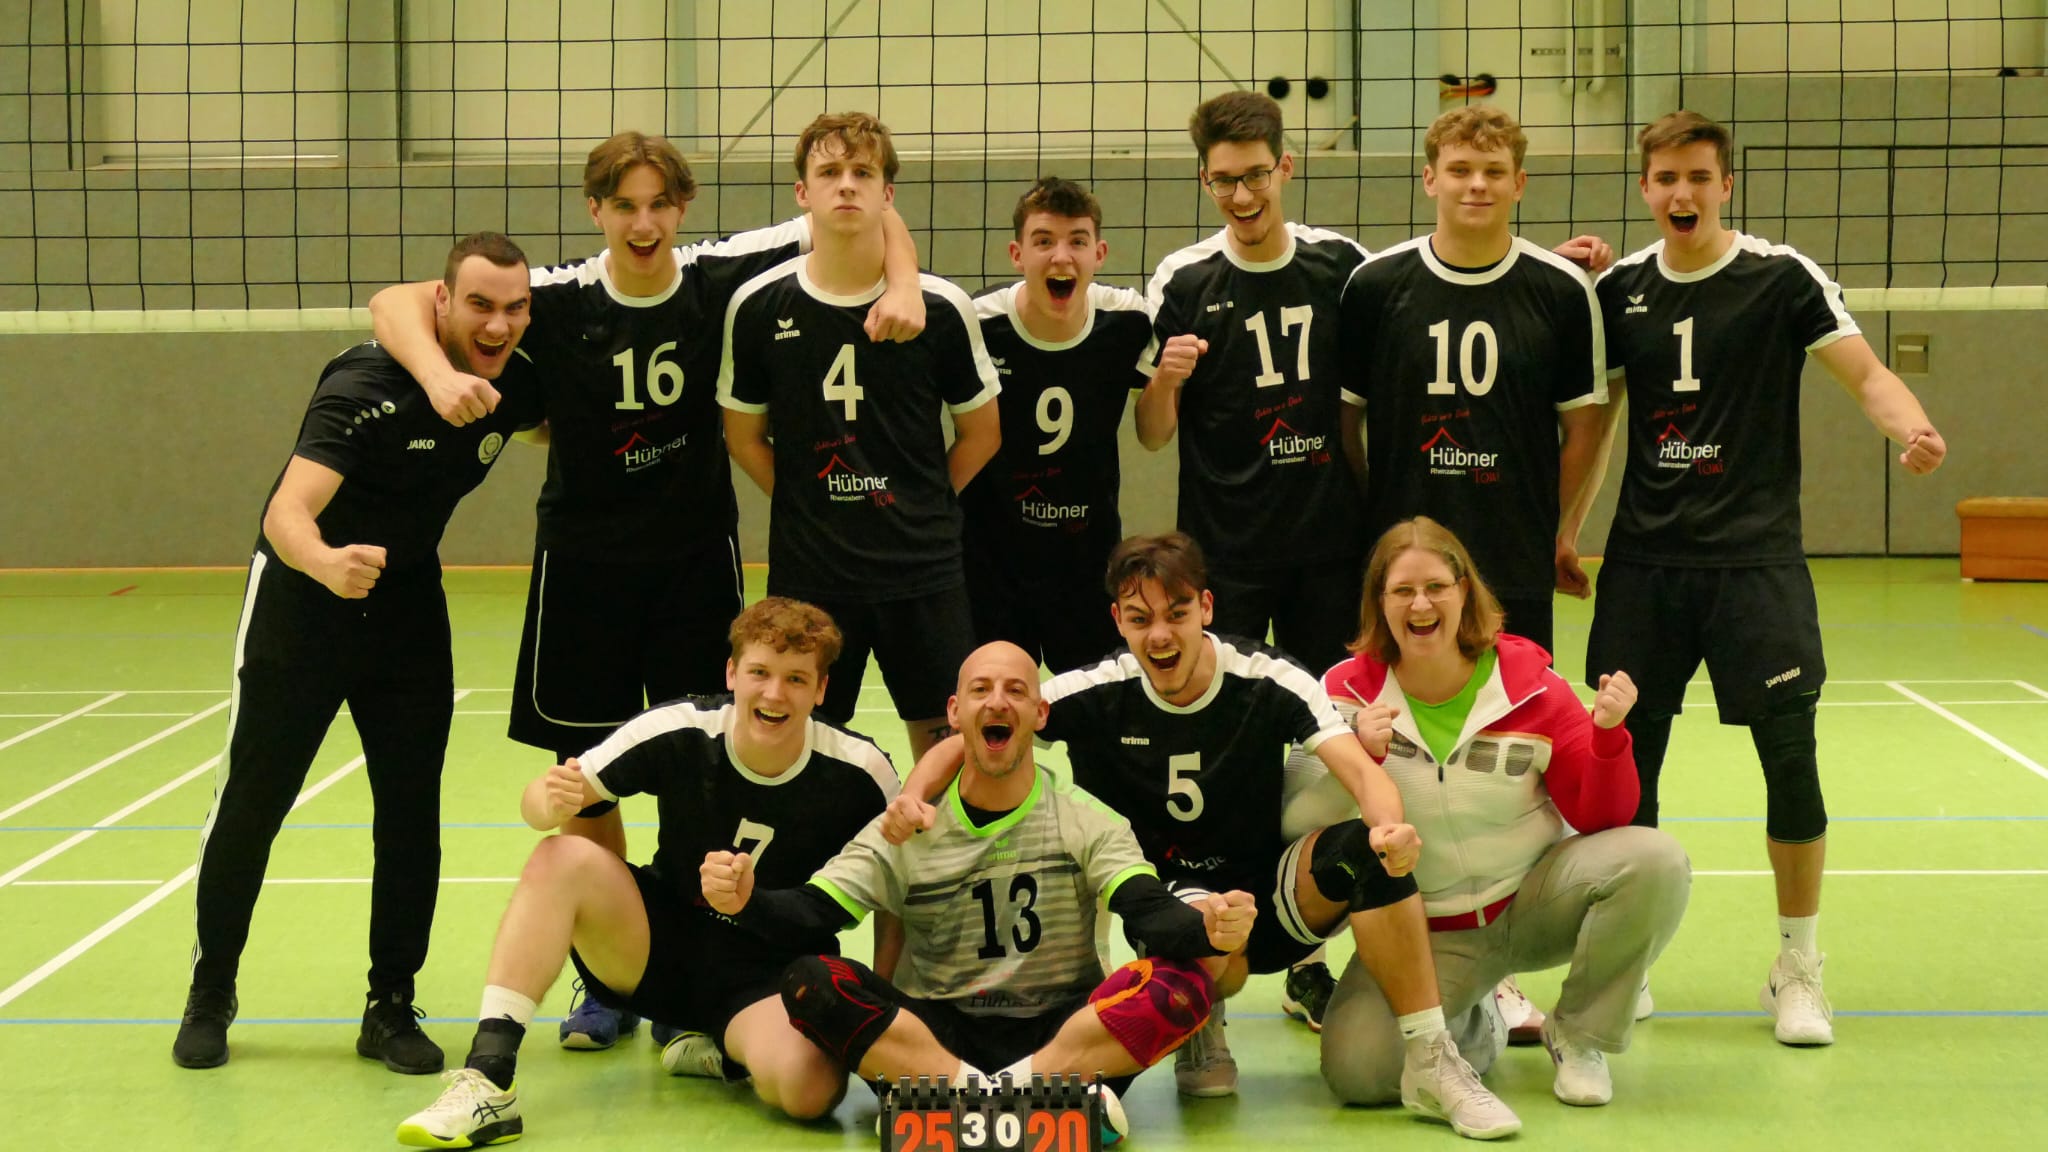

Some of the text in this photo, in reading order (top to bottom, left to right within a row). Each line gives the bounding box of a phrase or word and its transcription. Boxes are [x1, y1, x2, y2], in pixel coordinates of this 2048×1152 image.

[1206, 301, 1234, 312] eria
[774, 329, 801, 340] erima
[1245, 305, 1313, 388] 17
[1427, 319, 1499, 396] 10
[1673, 316, 1700, 392] 1
[612, 341, 685, 410] 16
[823, 343, 864, 421] 4
[1035, 386, 1074, 455] 9
[407, 439, 436, 450] JAKO
[625, 433, 688, 466] Hübner
[1270, 435, 1326, 456] Hübner
[1430, 447, 1499, 467] Hübner
[1660, 441, 1722, 459] Hübner
[827, 474, 888, 492] Hübner
[1022, 500, 1088, 519] Hübner
[1121, 736, 1150, 745] erima
[1166, 751, 1204, 822] 5
[733, 818, 775, 872] 7
[972, 873, 1041, 960] 13
[894, 1110, 1089, 1152] 25 3 0 20
